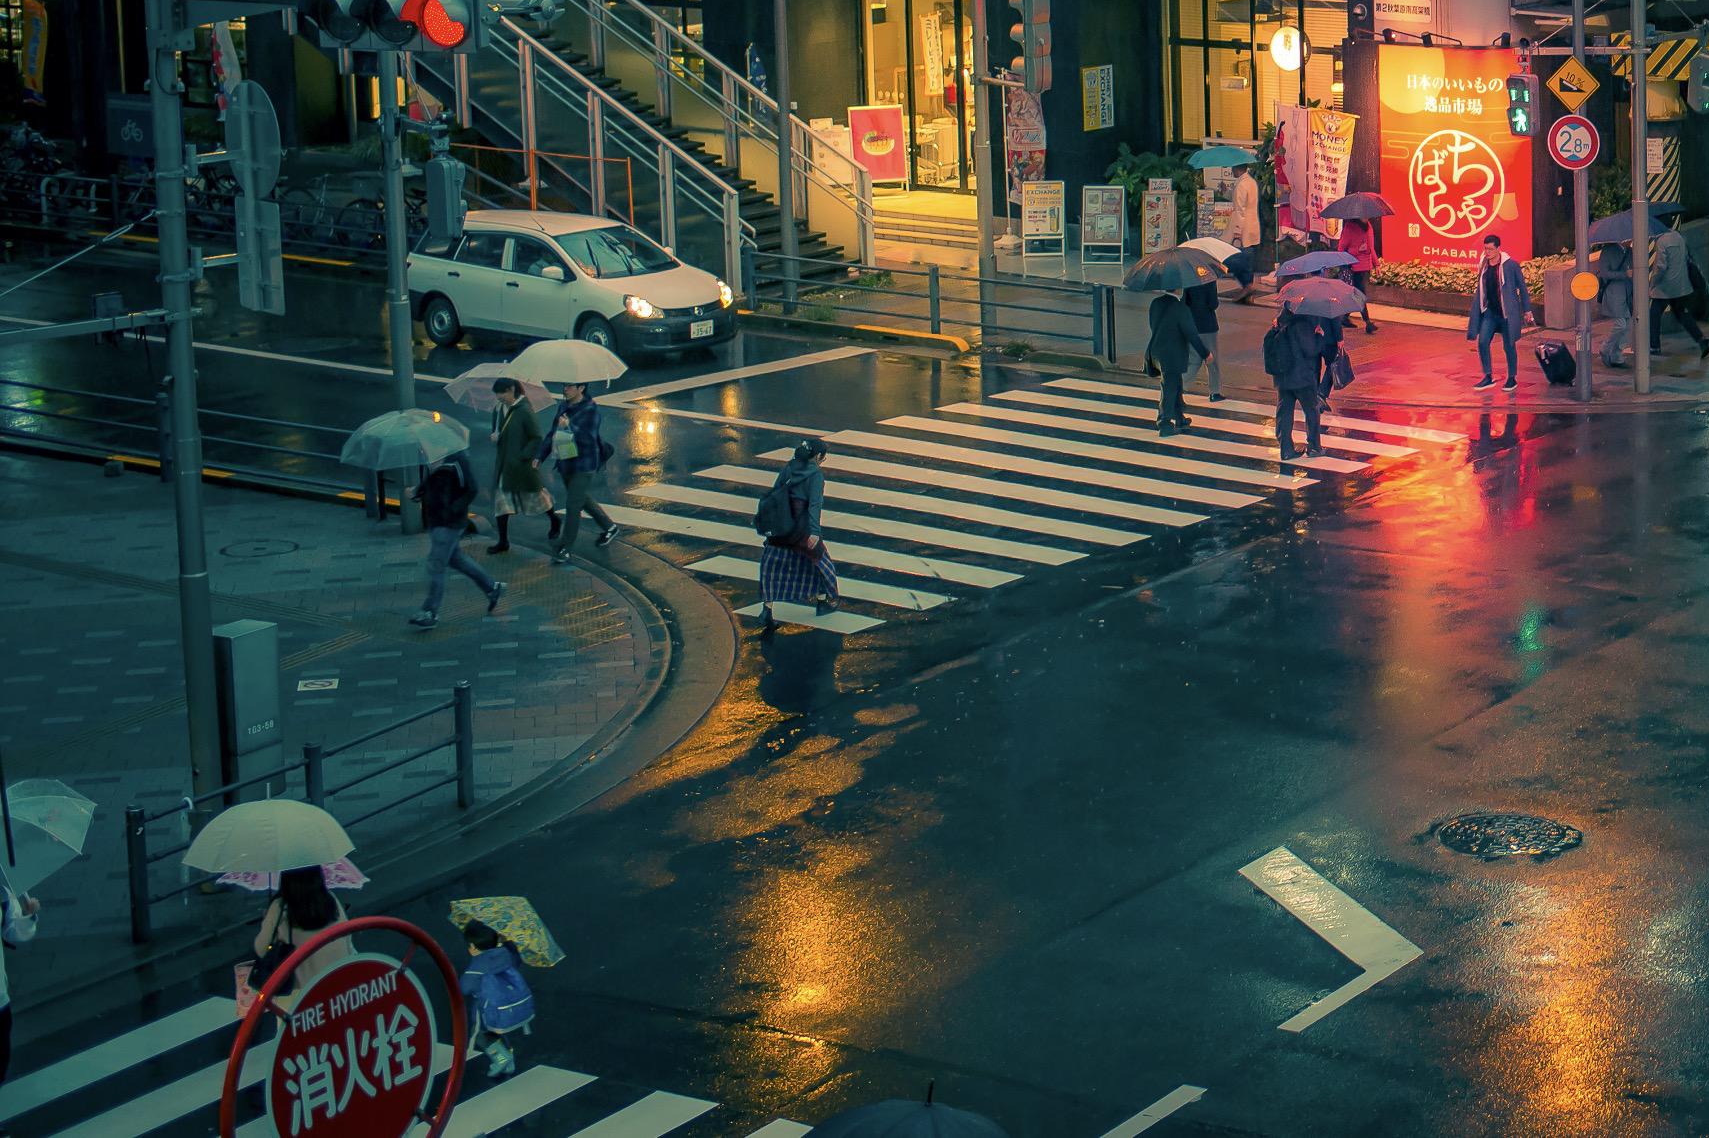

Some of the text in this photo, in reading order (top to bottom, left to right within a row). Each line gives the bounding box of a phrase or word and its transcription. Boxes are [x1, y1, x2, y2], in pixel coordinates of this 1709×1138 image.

[1407, 75, 1504, 94] 日本のいいもの
[1424, 96, 1483, 116] 逸品市場
[1311, 130, 1349, 145] MONEY
[1560, 130, 1590, 153] 2.8m
[1423, 246, 1478, 259] CHABAR
[292, 969, 399, 1037] FIRE HYDRANT
[282, 1004, 423, 1137] 消火栓
